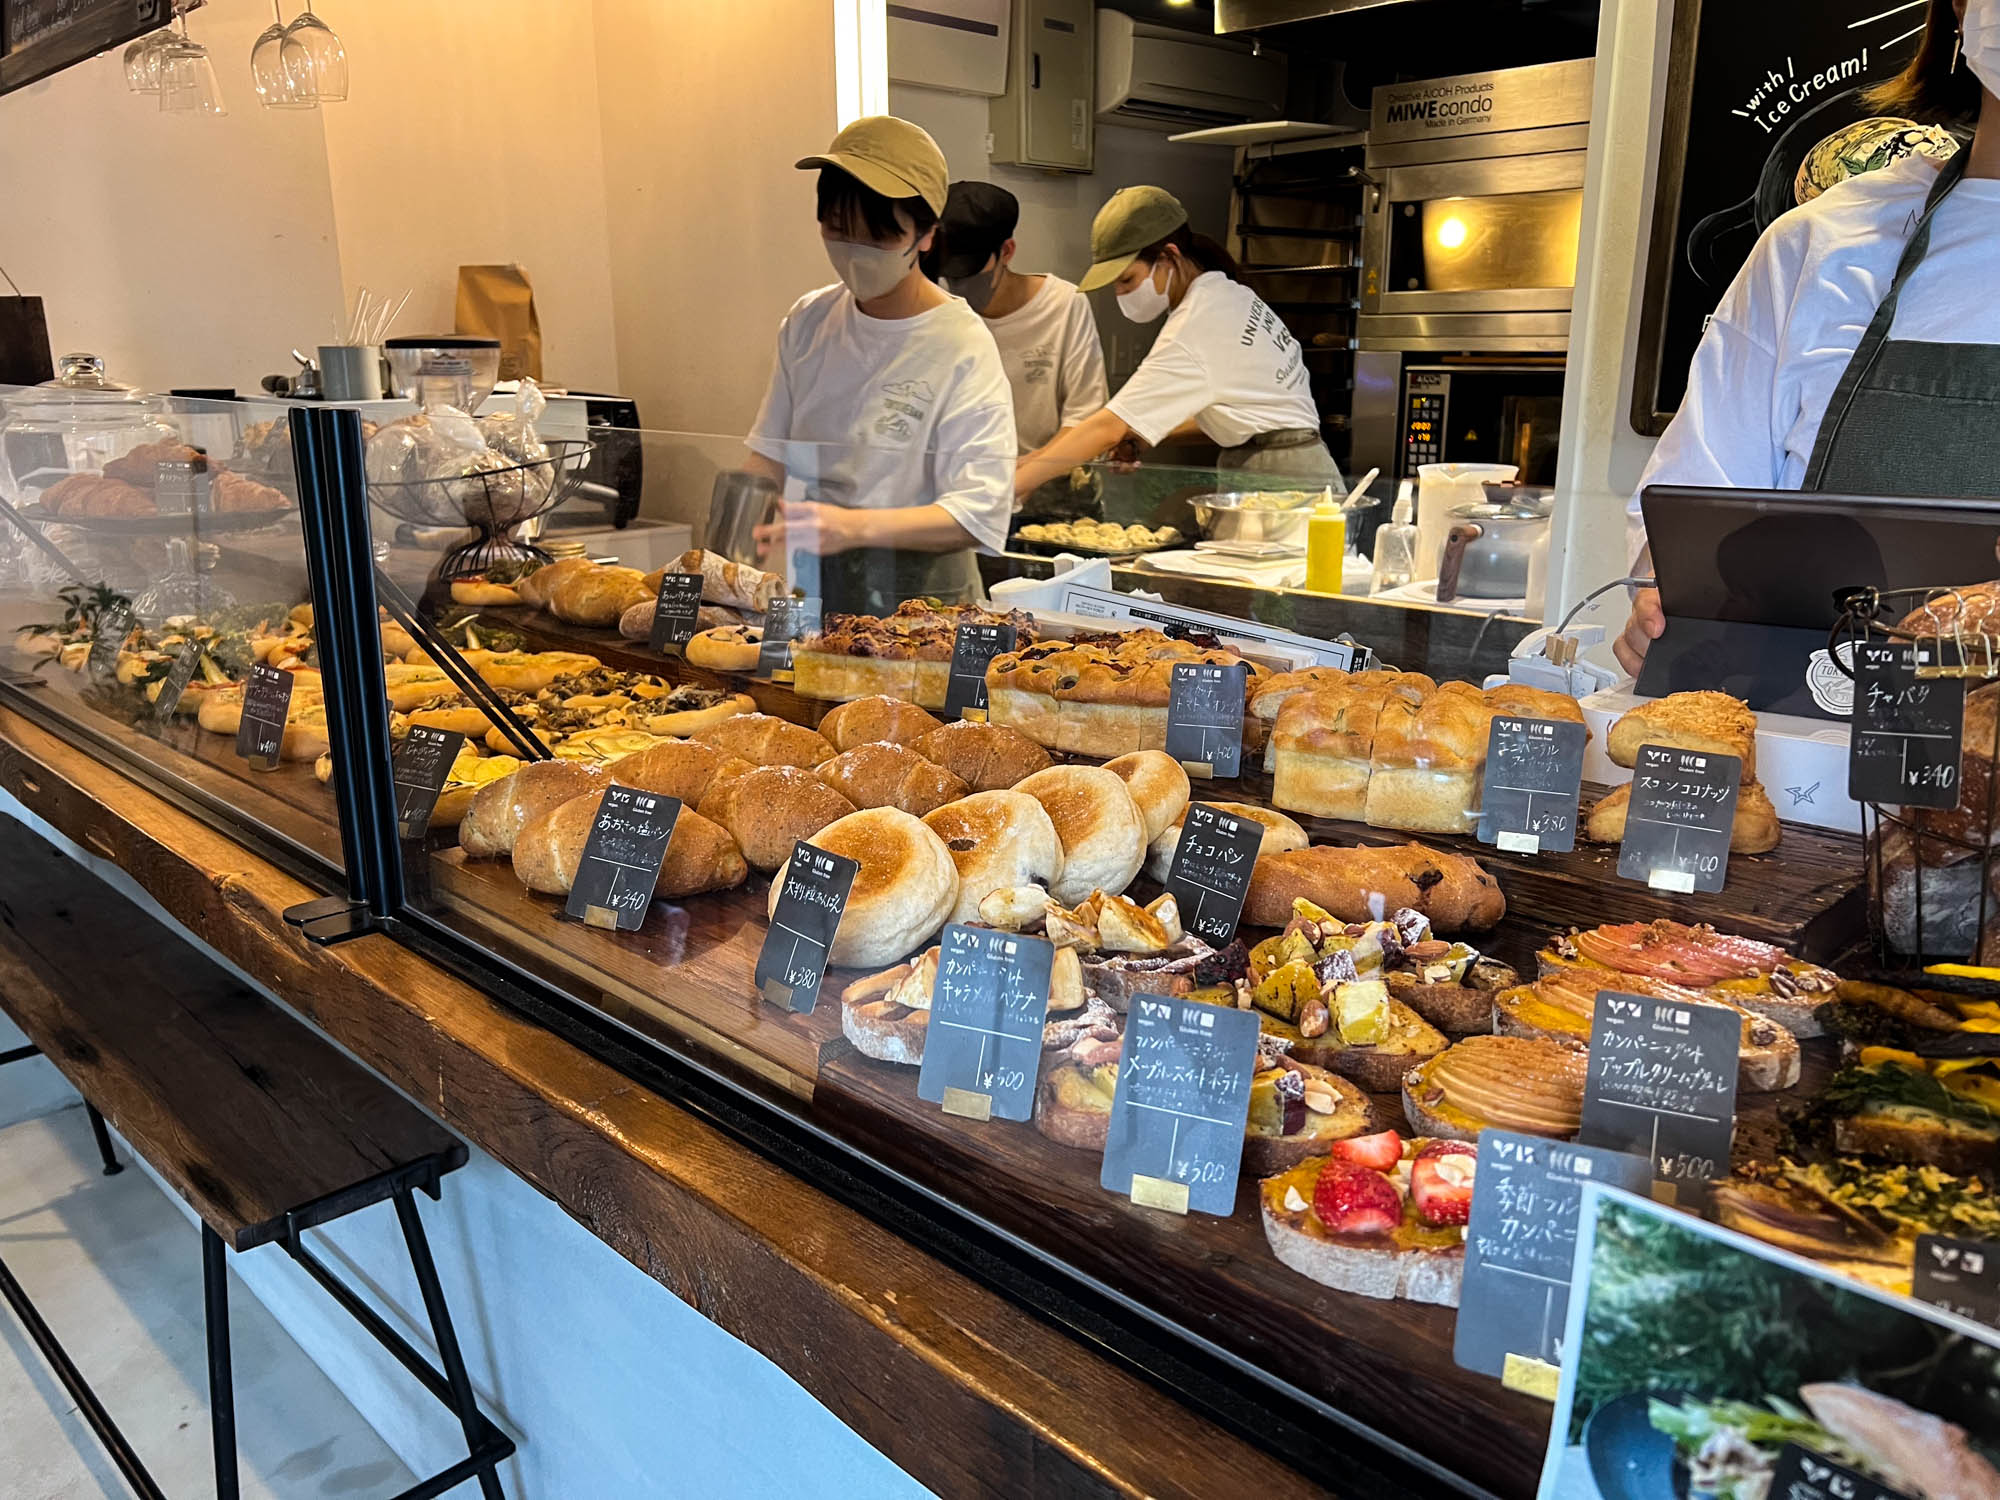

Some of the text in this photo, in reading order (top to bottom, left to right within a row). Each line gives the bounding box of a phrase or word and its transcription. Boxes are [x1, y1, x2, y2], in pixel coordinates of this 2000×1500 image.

[1455, 82, 1494, 95] Products
[1746, 70, 1785, 110] with
[1754, 48, 1868, 133] Ice Cream!
[1909, 764, 1956, 788] ¥340
[1532, 814, 1568, 833] ¥380
[1185, 834, 1245, 865] チョコパン
[611, 889, 646, 911] ¥340
[1198, 917, 1231, 938] ¥360
[789, 966, 817, 990] ¥380
[984, 1066, 1025, 1091] ¥500
[1176, 1152, 1225, 1184] ¥500
[1660, 1152, 1715, 1180] ¥500
